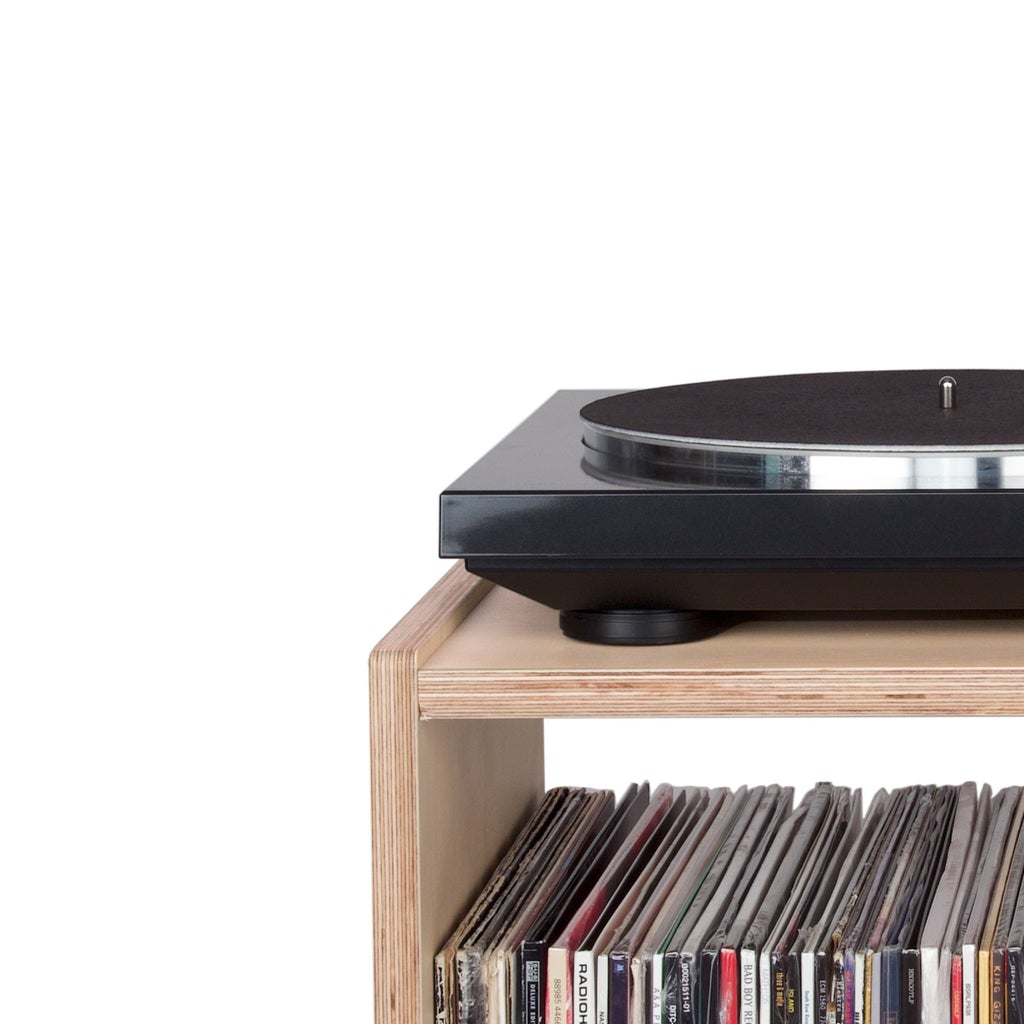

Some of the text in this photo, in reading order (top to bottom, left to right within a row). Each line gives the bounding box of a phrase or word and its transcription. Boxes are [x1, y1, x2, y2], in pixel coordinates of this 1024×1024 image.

[743, 964, 753, 985] BAD
[992, 965, 1001, 993] KING
[529, 983, 537, 1010] DELUXE
[553, 978, 562, 1004] 88985
[743, 987, 753, 1007] BOY
